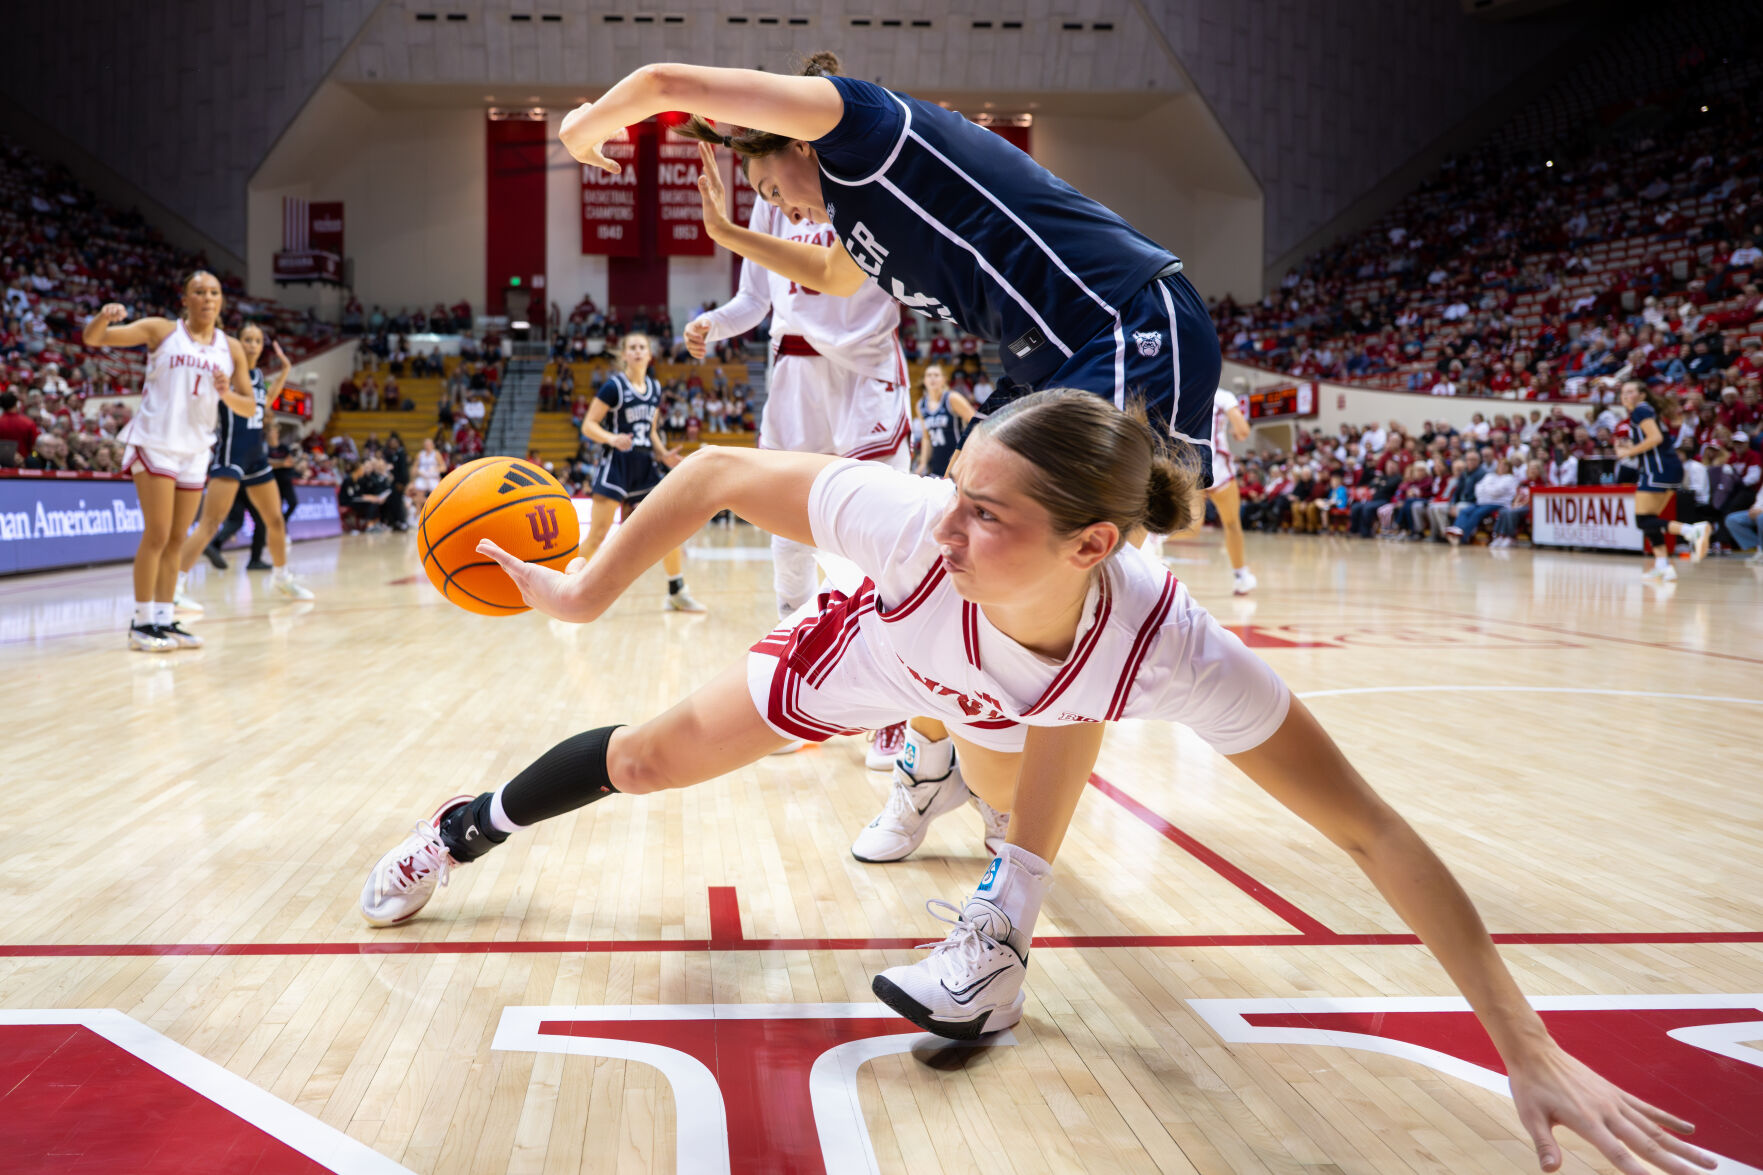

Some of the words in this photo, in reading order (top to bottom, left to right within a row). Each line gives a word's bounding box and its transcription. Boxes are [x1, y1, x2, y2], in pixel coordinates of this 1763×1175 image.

[659, 163, 698, 185] NCA
[34, 501, 109, 539] American
[1545, 495, 1628, 526] INDIANA
